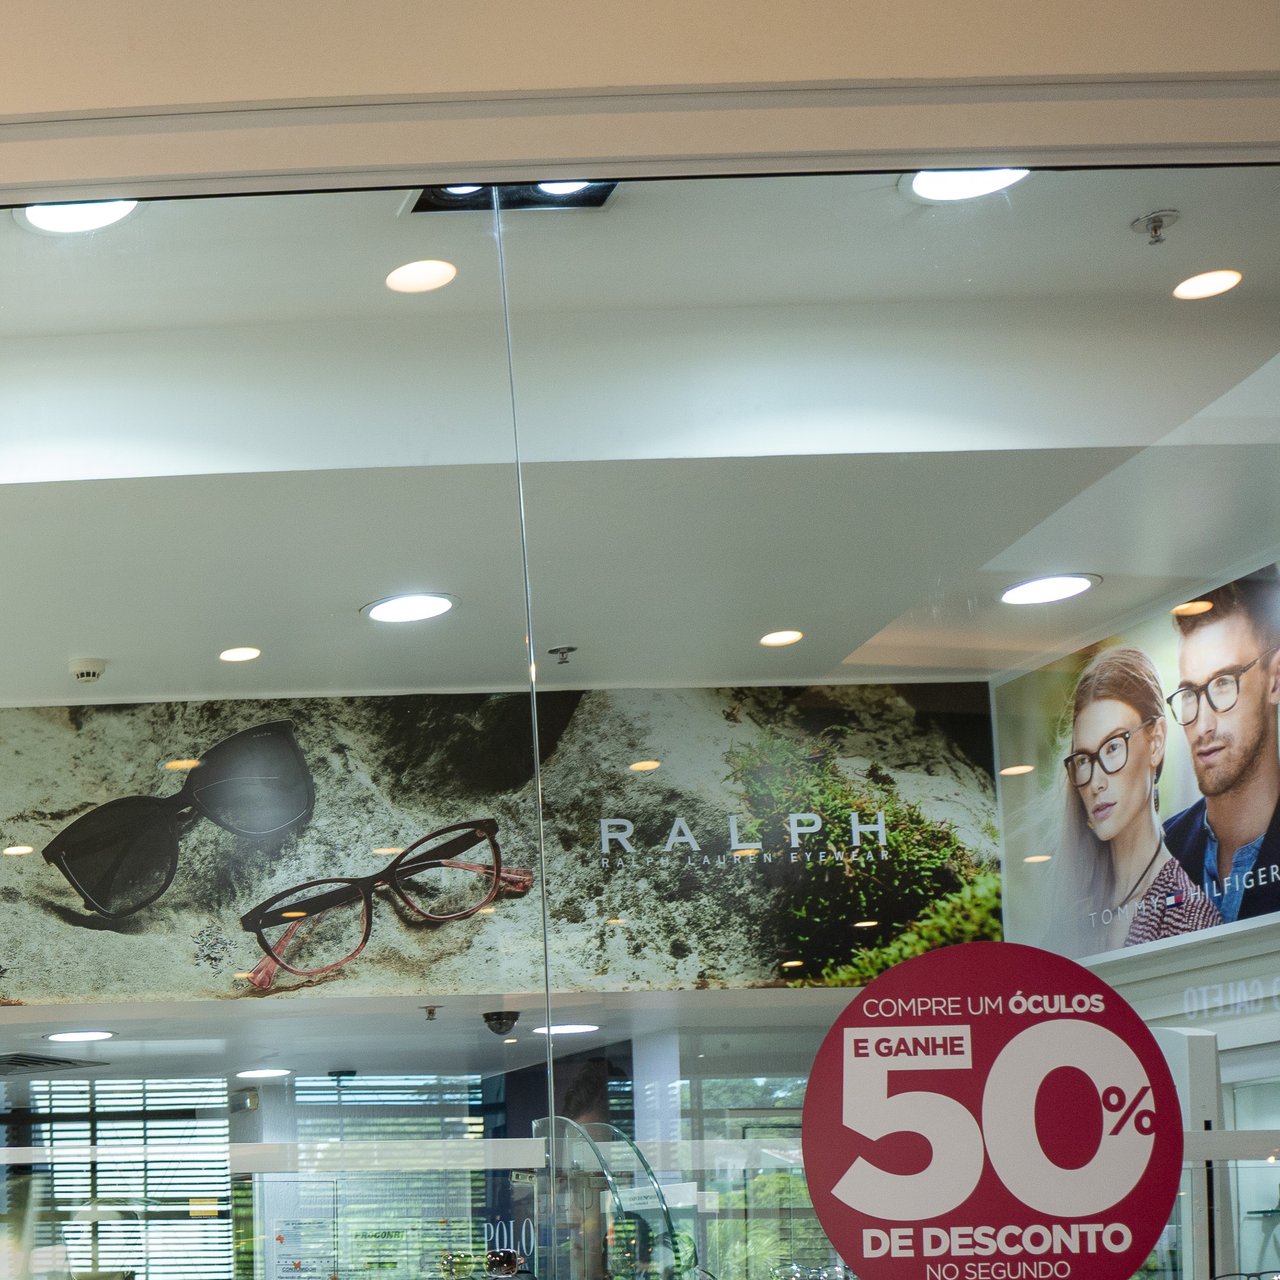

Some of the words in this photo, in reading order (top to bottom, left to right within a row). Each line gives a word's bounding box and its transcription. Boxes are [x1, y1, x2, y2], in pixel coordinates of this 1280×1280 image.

[600, 811, 887, 853] RALPH
[601, 855, 670, 868] RALPH
[688, 852, 773, 867] LAUREN
[790, 849, 889, 864] EYEWEAR
[1088, 896, 1161, 929] TOMMY
[1188, 863, 1280, 901] HILFIGER
[863, 996, 961, 1018] COMPRE
[967, 995, 1003, 1016] UM
[1008, 990, 1106, 1015] ÓCULOS
[853, 1038, 870, 1058] E
[875, 1035, 965, 1058] GANHE
[830, 1018, 1157, 1221] 50%
[484, 1217, 535, 1257] POLO
[862, 1228, 914, 1258] DE
[922, 1222, 1133, 1258] DESCONTO
[926, 1263, 959, 1280] NO
[964, 1260, 1071, 1280] SEGUNDO
